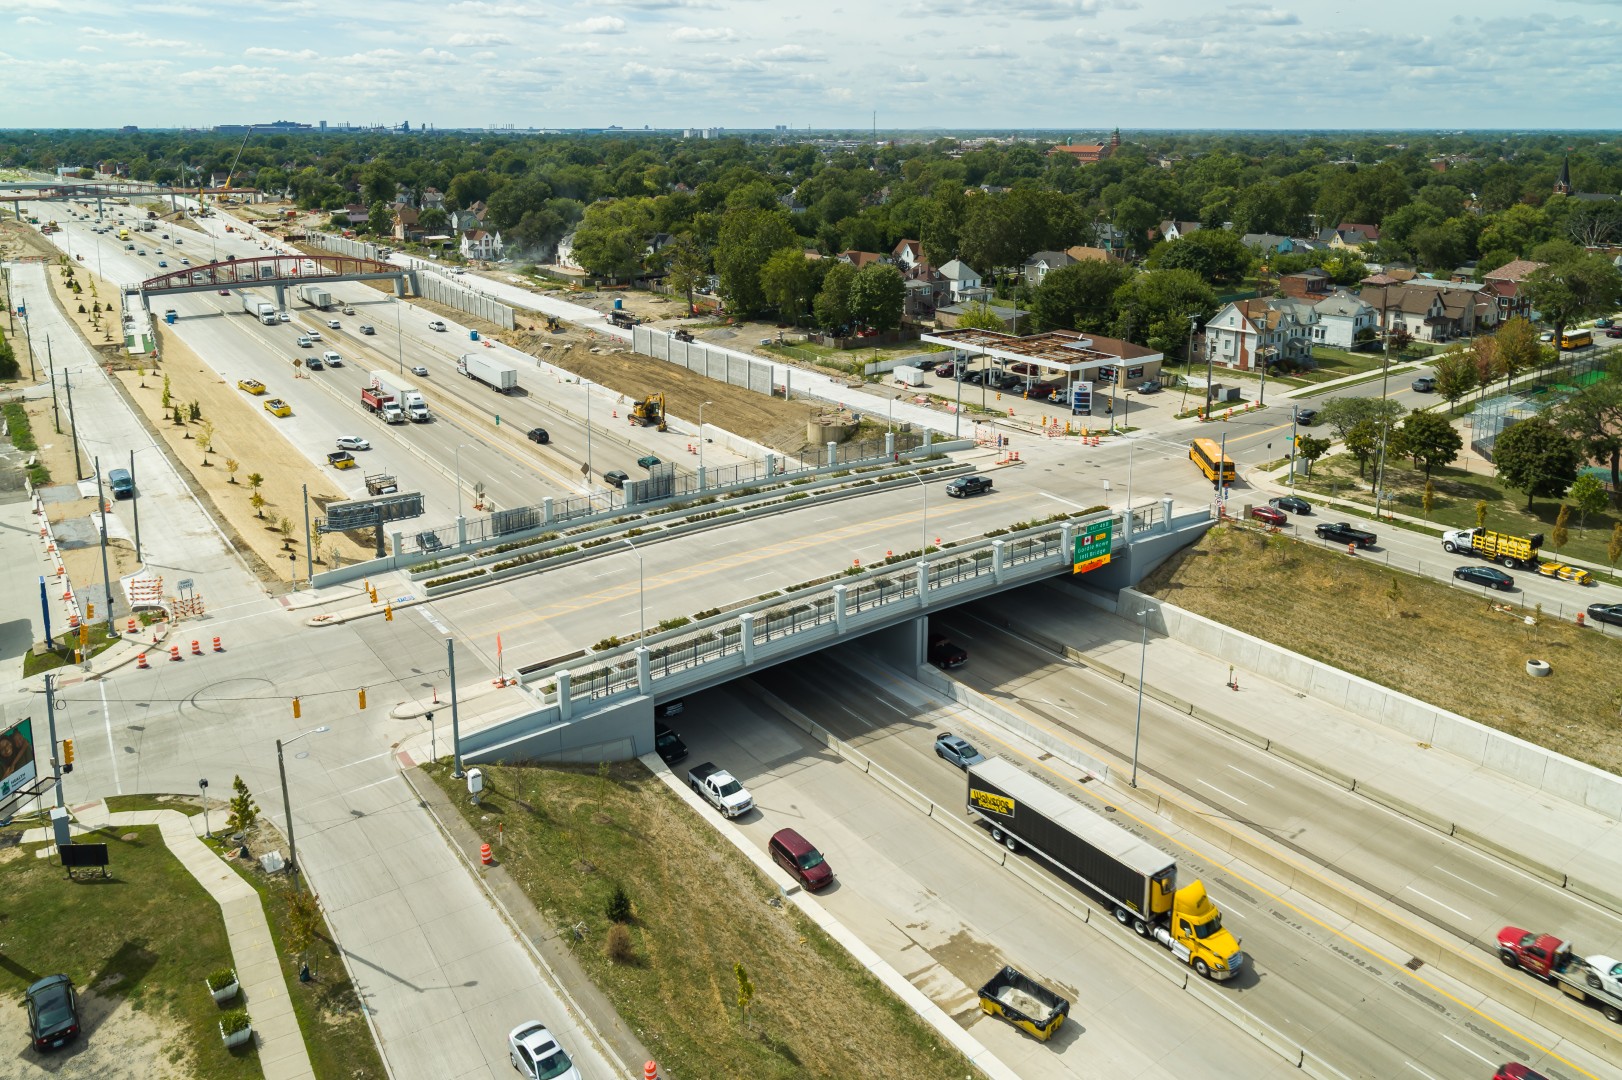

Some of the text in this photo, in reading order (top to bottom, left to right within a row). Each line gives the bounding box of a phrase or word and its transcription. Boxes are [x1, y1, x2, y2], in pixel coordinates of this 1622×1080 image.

[1078, 545, 1094, 554] Gordie
[1090, 548, 1106, 556] Bridge
[10, 772, 26, 784] HEALTH
[974, 790, 1009, 808] Wolverine
